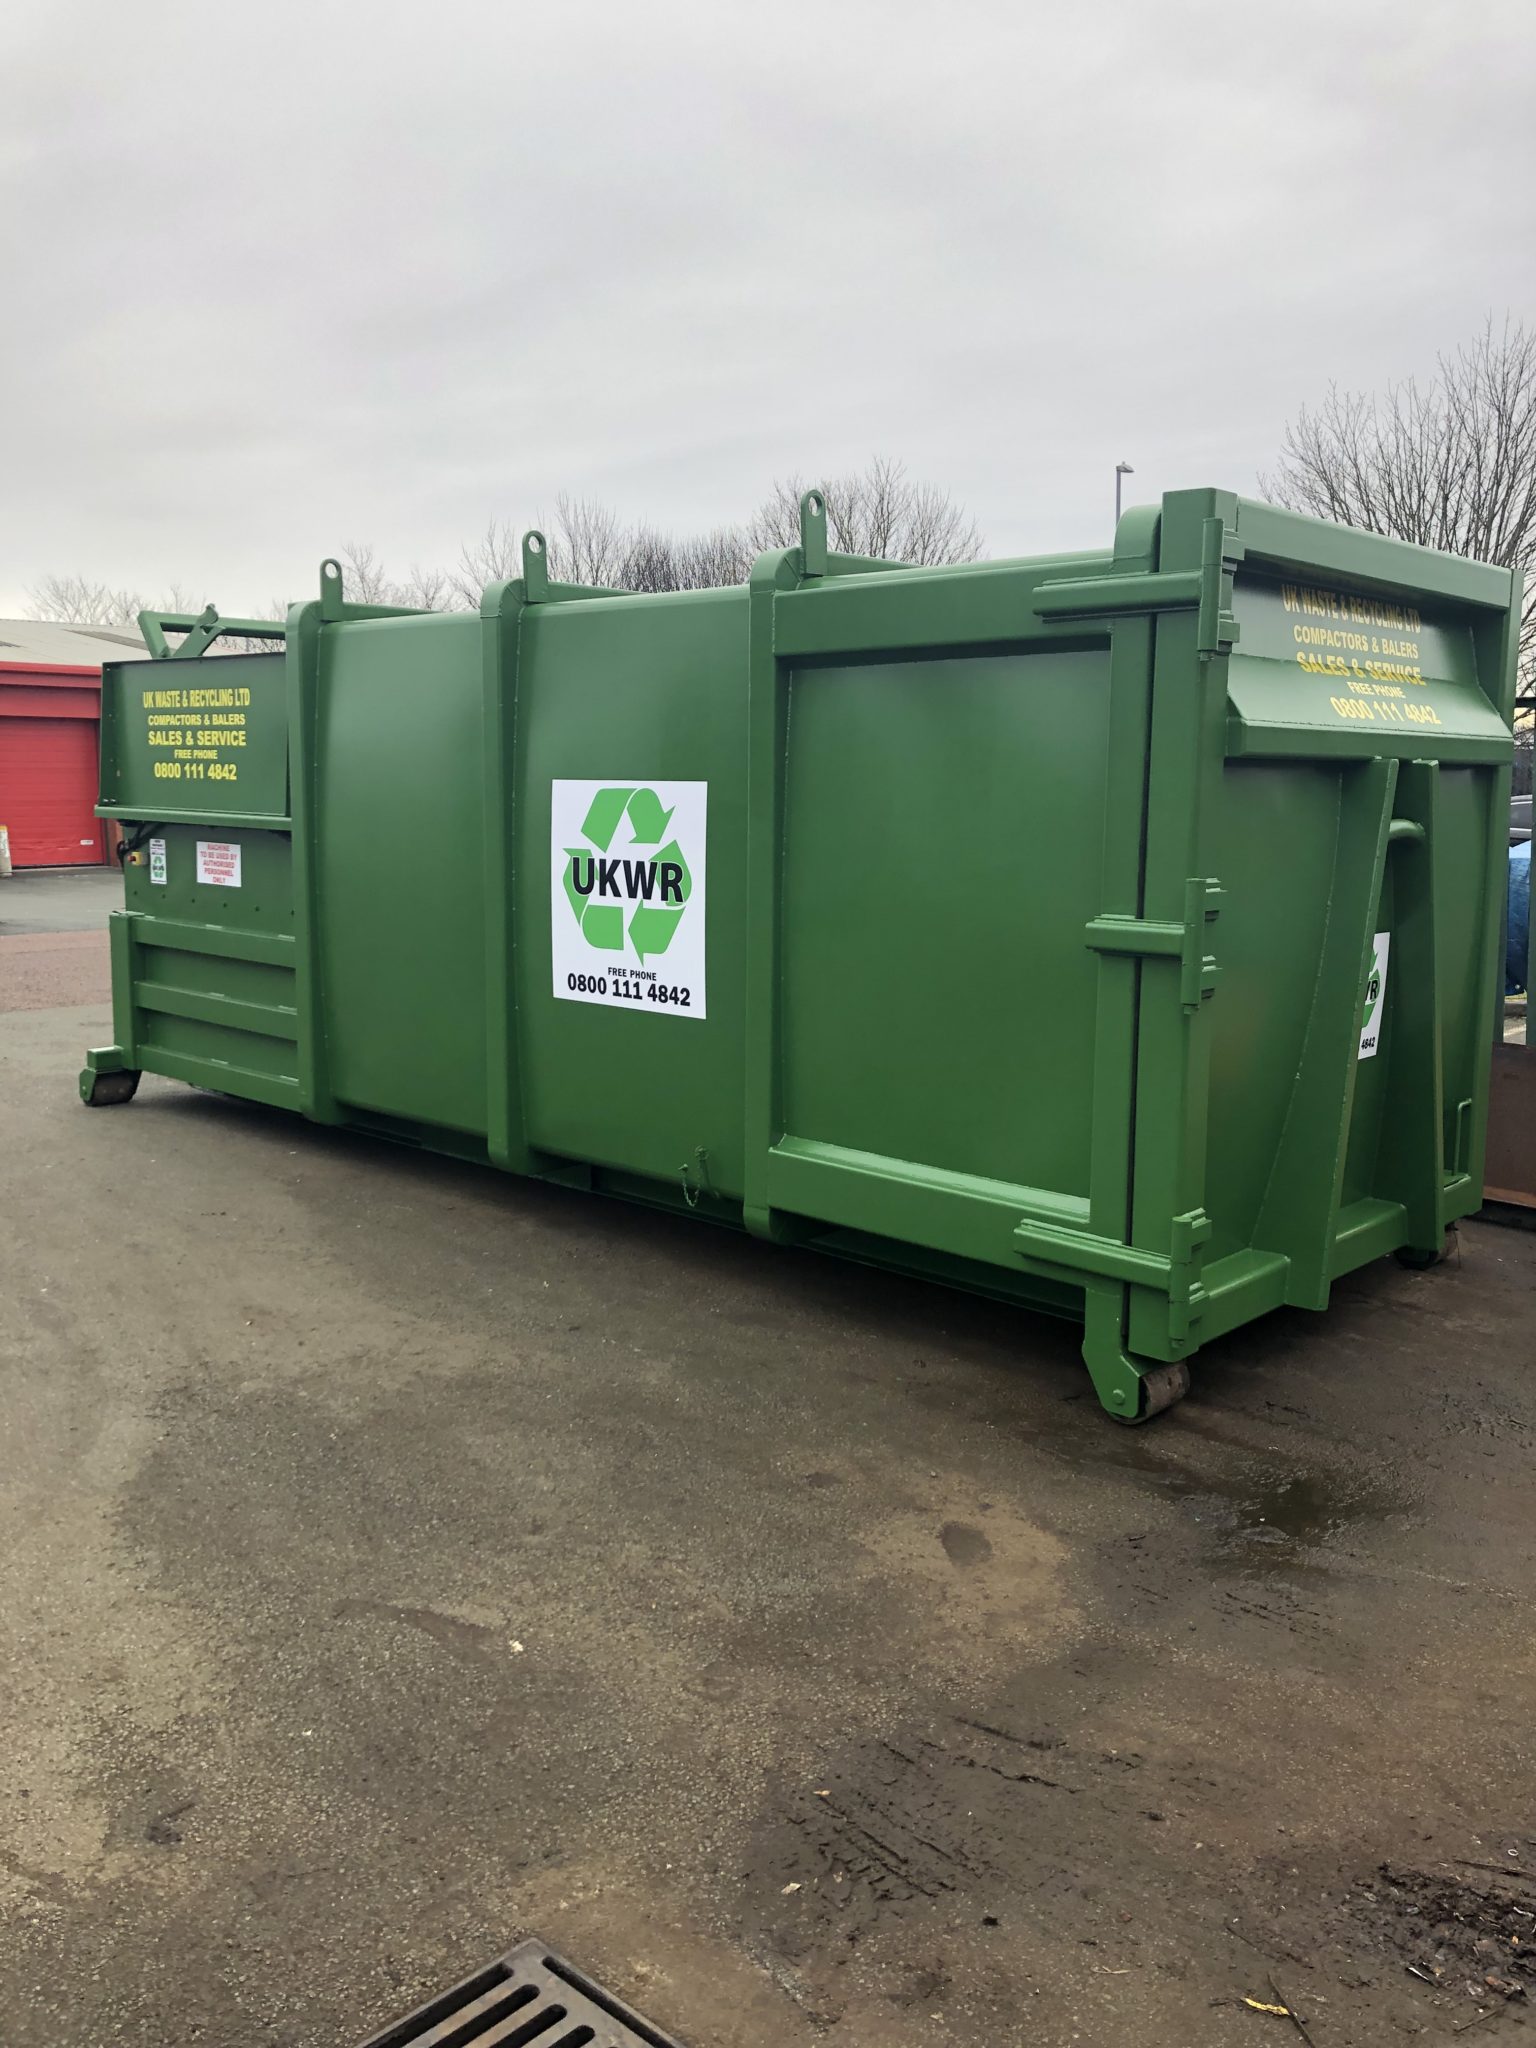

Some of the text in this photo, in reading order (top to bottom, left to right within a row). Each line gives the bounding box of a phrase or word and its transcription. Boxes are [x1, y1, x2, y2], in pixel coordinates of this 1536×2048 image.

[1283, 584, 1421, 633] UK WASTE & RECYCLING LTD
[1294, 625, 1419, 659] COMPACTORS & BALERS
[1297, 652, 1426, 686] SALES & SERVICE
[144, 688, 250, 708] UK WASTE & RECYCLING LTD
[1348, 682, 1406, 698] FREE PHONE
[148, 714, 245, 725] COMPACTORS & BALERS
[1330, 697, 1441, 724] 0800 111 4842
[148, 731, 246, 746] SALES & SERVICE
[174, 750, 218, 759] FREE PHONE
[154, 762, 237, 780] 0800 111 4842
[572, 857, 683, 902] UKWR
[608, 967, 656, 981] FREE PHONE
[568, 973, 690, 1006] 0800 111 4842
[1361, 1037, 1375, 1050] 4842
